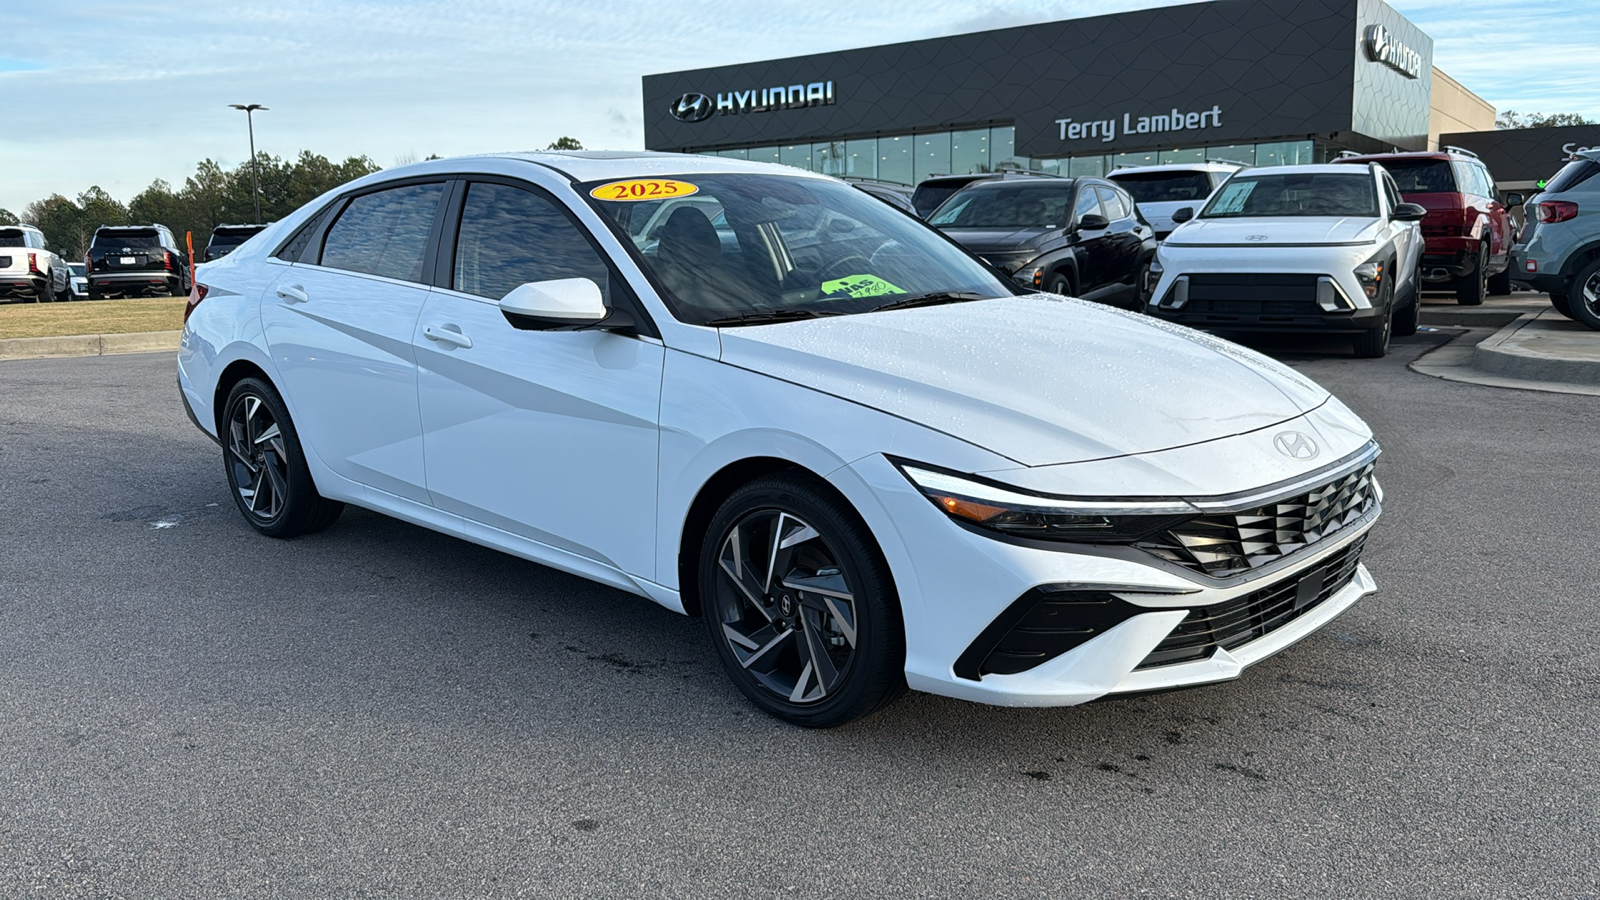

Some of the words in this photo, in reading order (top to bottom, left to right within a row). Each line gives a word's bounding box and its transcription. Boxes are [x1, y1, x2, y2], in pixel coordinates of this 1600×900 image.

[1389, 35, 1421, 79] HYUNDAI
[717, 80, 833, 112] HYUNDAI
[1055, 118, 1116, 142] Terry
[1123, 105, 1222, 135] Lambert
[613, 182, 678, 199] 2025
